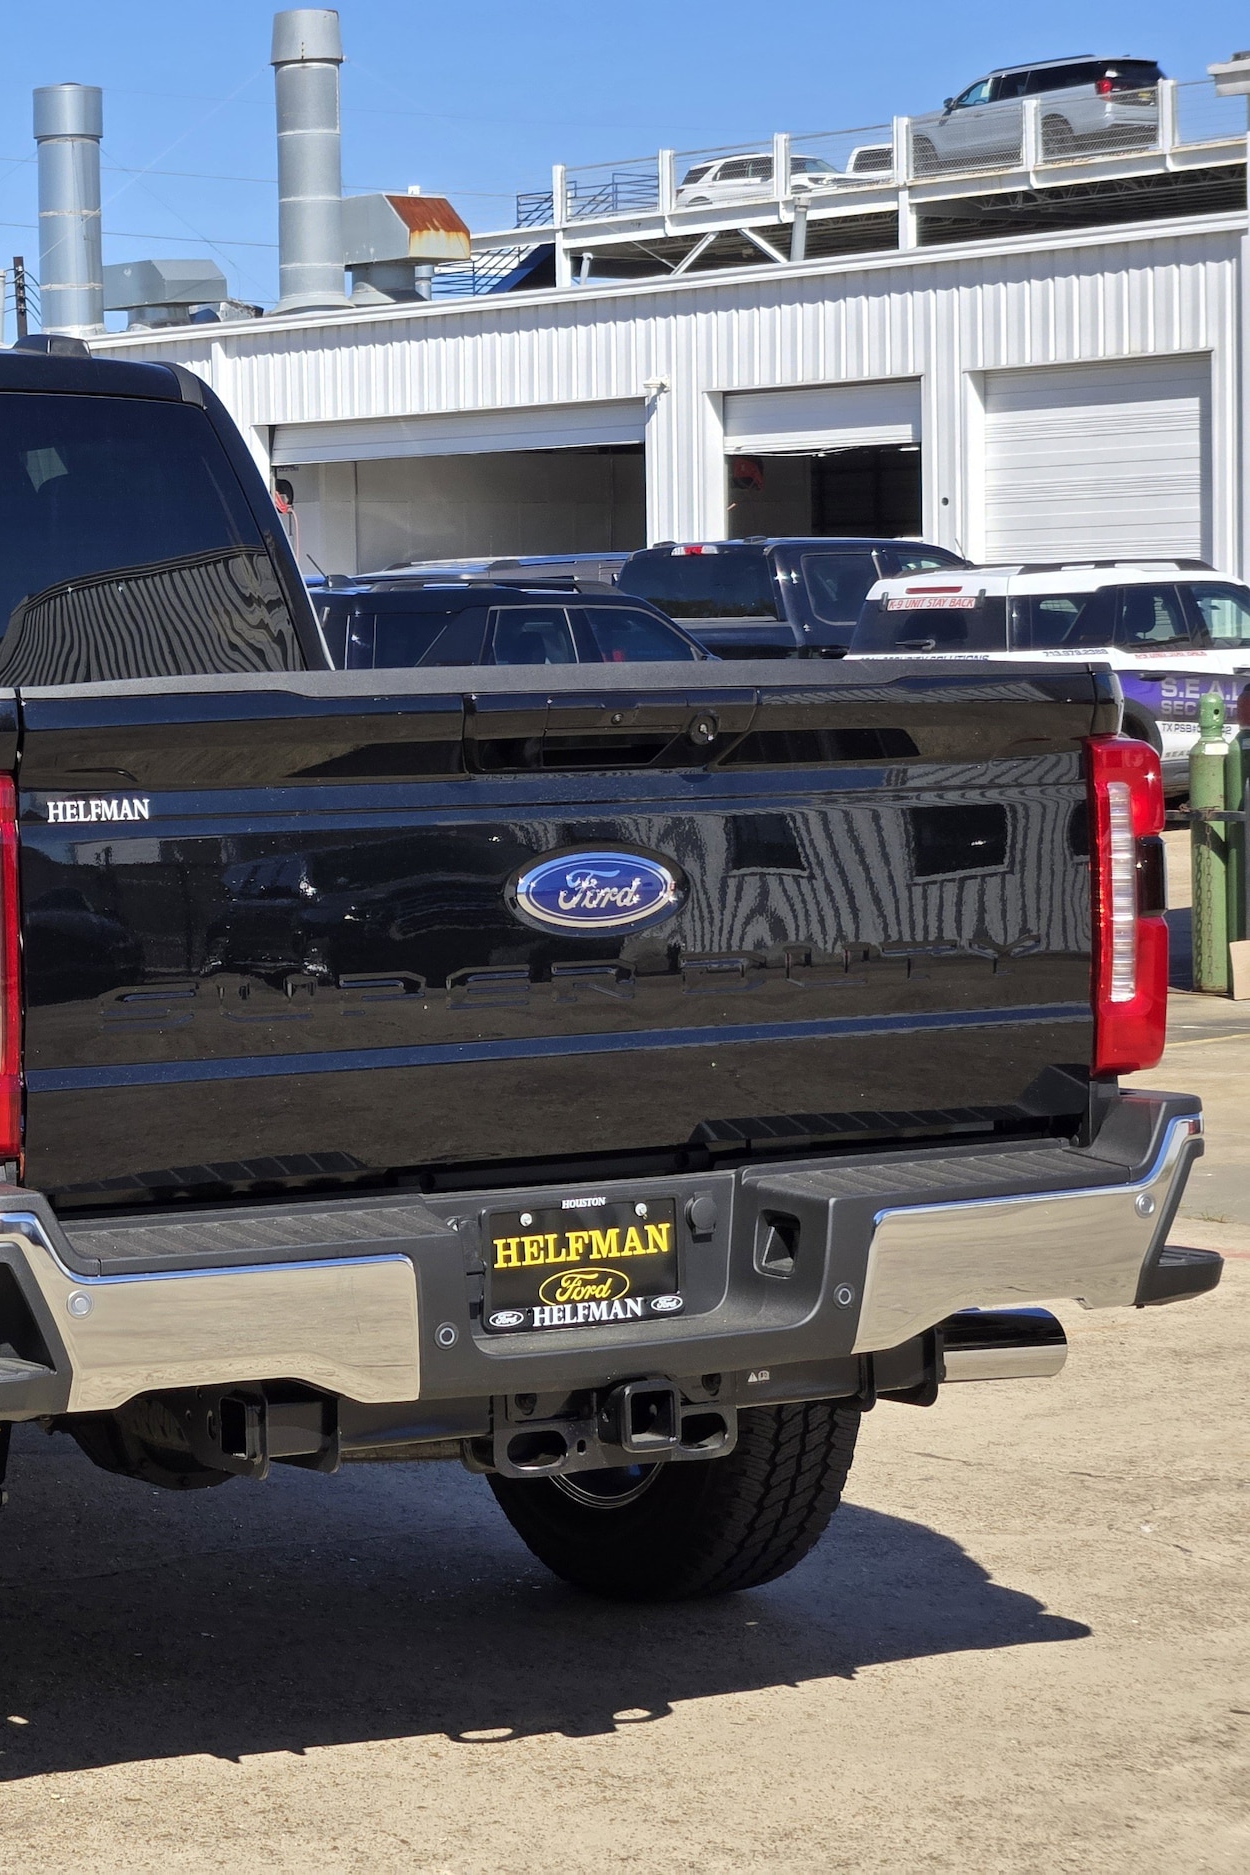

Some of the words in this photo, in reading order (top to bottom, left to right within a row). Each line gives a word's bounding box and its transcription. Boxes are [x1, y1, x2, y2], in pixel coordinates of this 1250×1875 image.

[888, 600, 904, 610] K-9
[905, 599, 924, 609] UNIT
[926, 598, 947, 608] STAY
[949, 598, 975, 608] BACK
[47, 798, 150, 823] HELFMAN
[558, 869, 641, 910] Ford
[562, 1197, 607, 1210] HOUSTON
[493, 1222, 671, 1269] HELFMAN
[555, 1272, 613, 1302] Ford
[494, 1313, 519, 1325] Ford
[532, 1297, 645, 1328] HELFMAN
[656, 1296, 679, 1309] Ford
